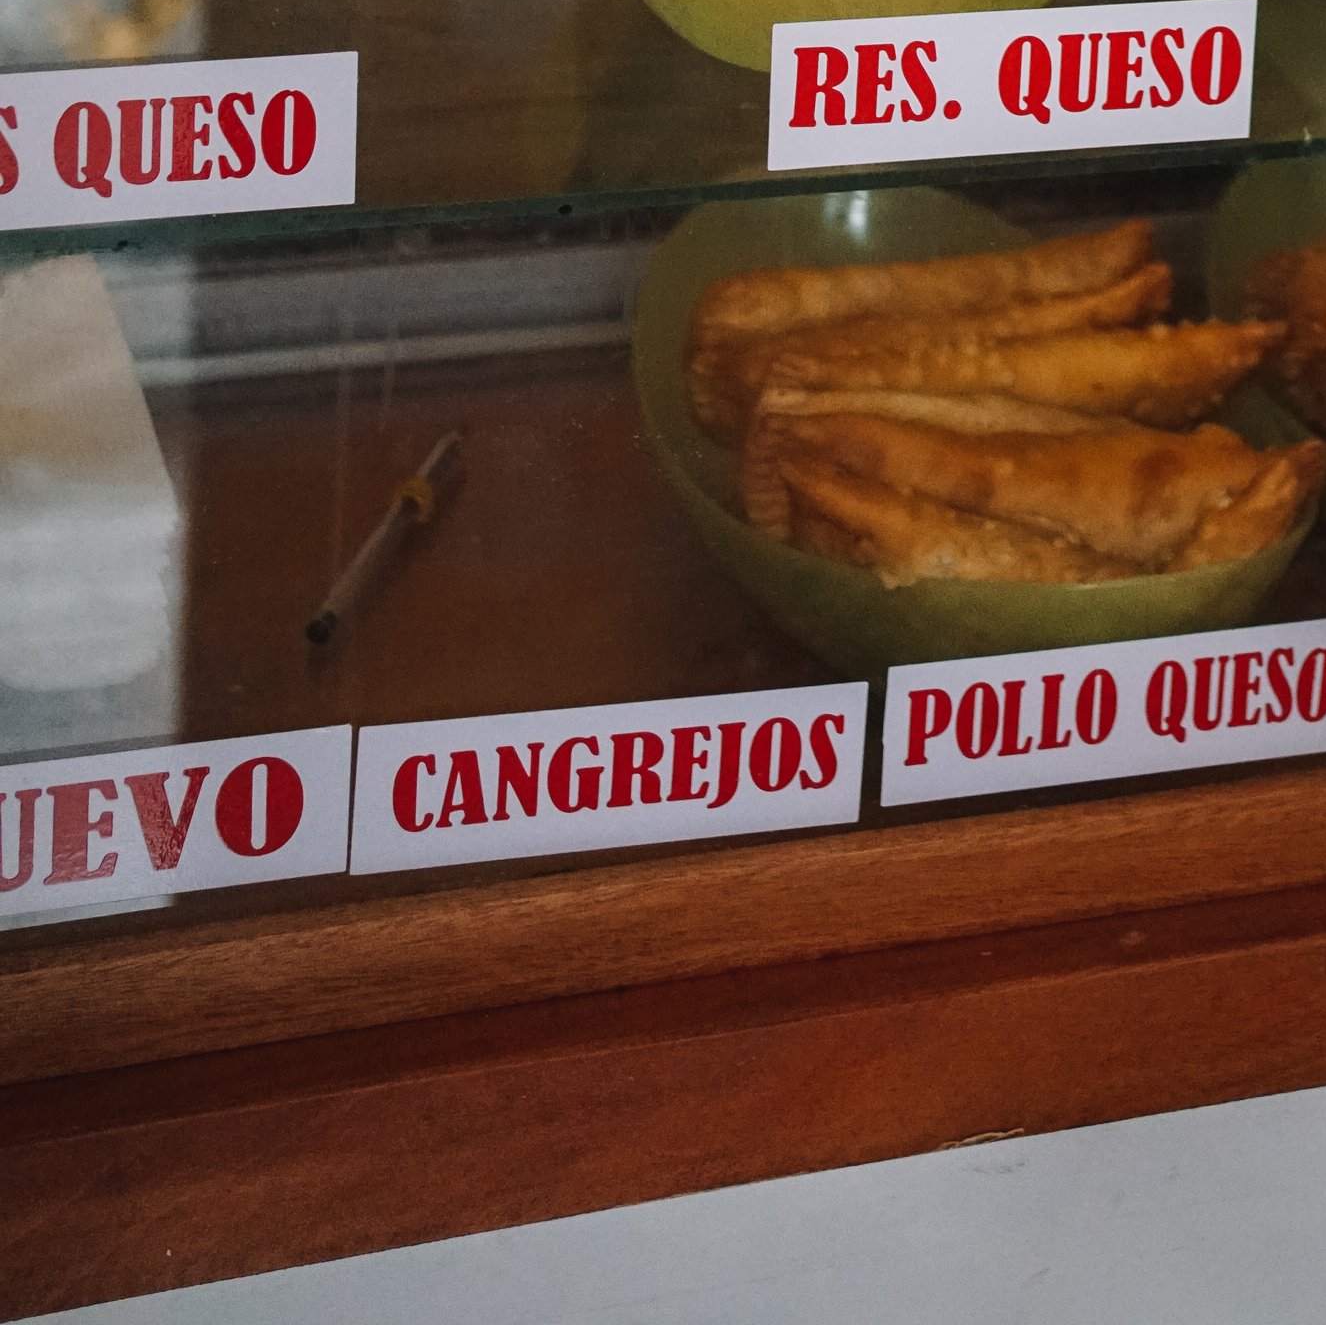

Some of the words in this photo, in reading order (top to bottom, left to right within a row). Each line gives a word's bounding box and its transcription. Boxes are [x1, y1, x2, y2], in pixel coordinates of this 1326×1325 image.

[788, 39, 962, 129] RES.
[997, 24, 1243, 125] QUESO
[53, 89, 317, 198] QUESO
[904, 667, 1120, 767] POLLO
[391, 712, 847, 833] CANGREJOS
